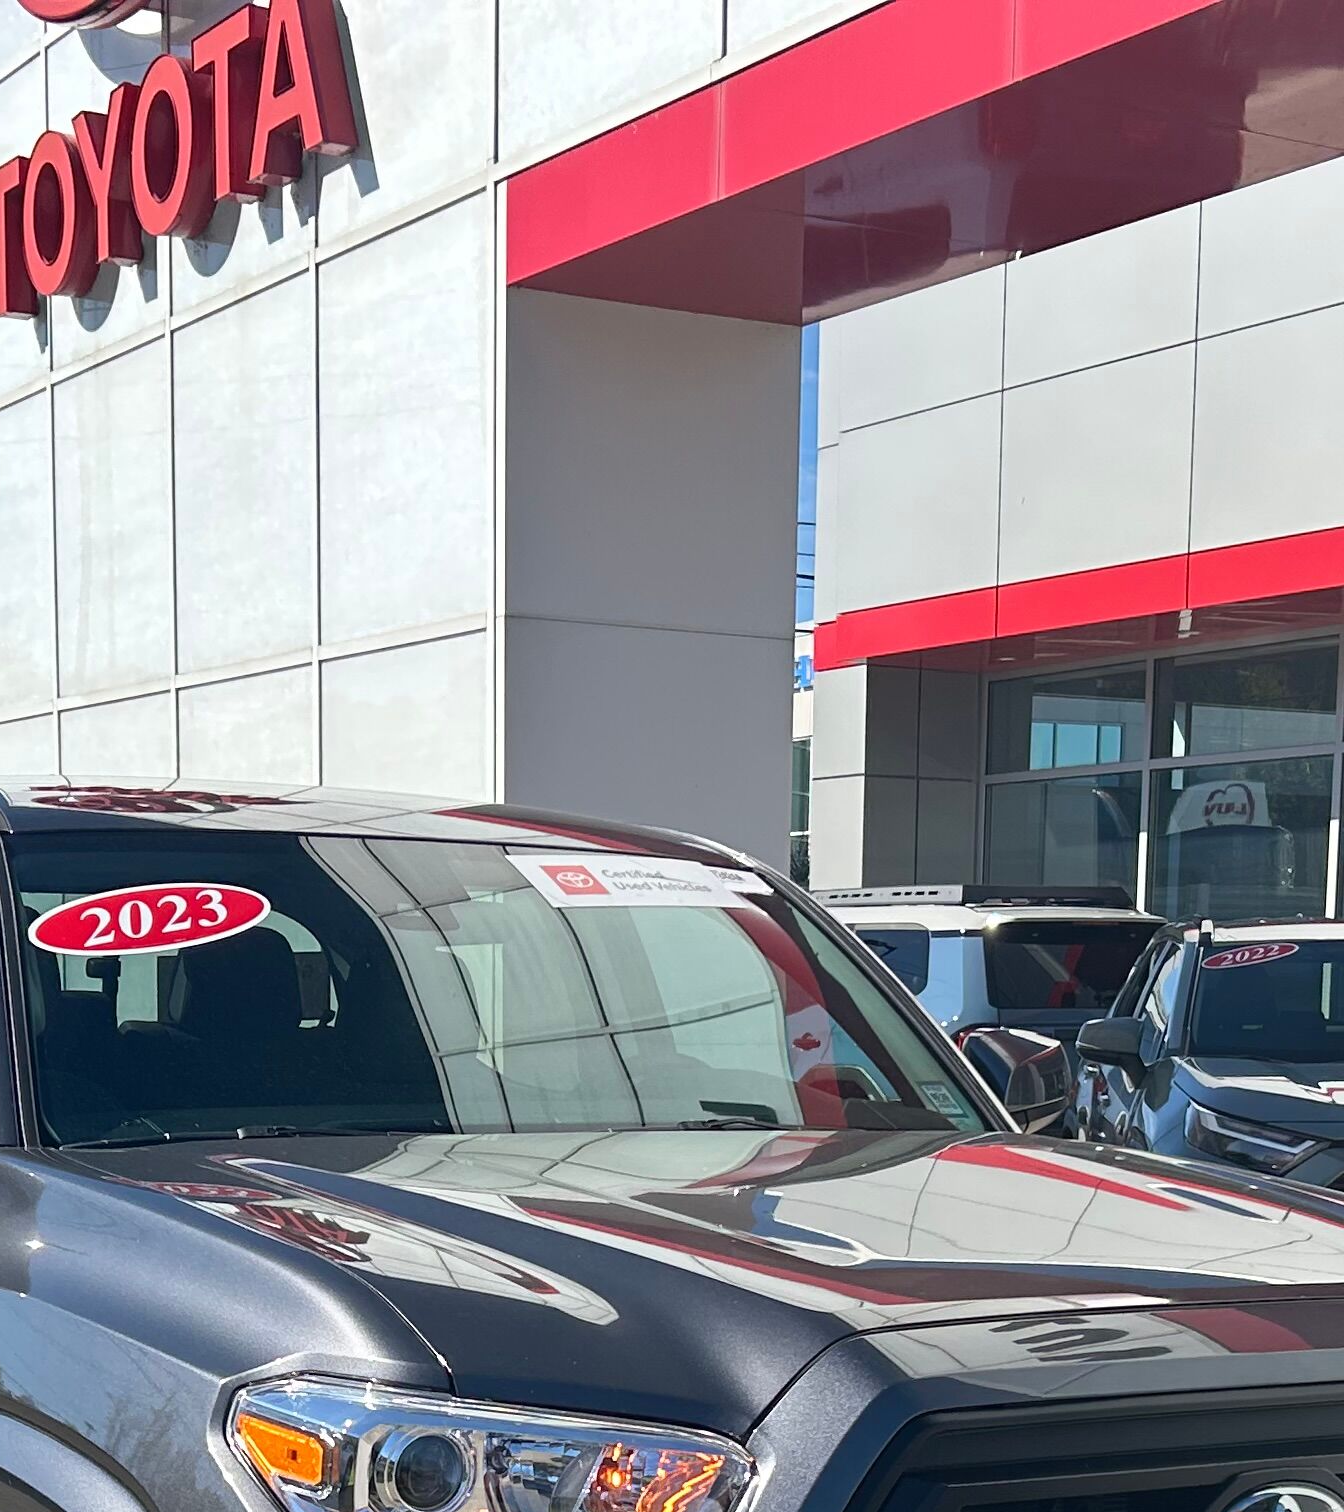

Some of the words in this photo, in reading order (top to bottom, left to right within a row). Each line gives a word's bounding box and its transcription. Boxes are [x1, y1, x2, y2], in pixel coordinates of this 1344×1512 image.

[601, 868, 665, 880] Certified
[612, 881, 652, 892] Used
[652, 881, 713, 893] Vehicles
[79, 888, 228, 948] 2023
[1220, 945, 1280, 966] 2022
